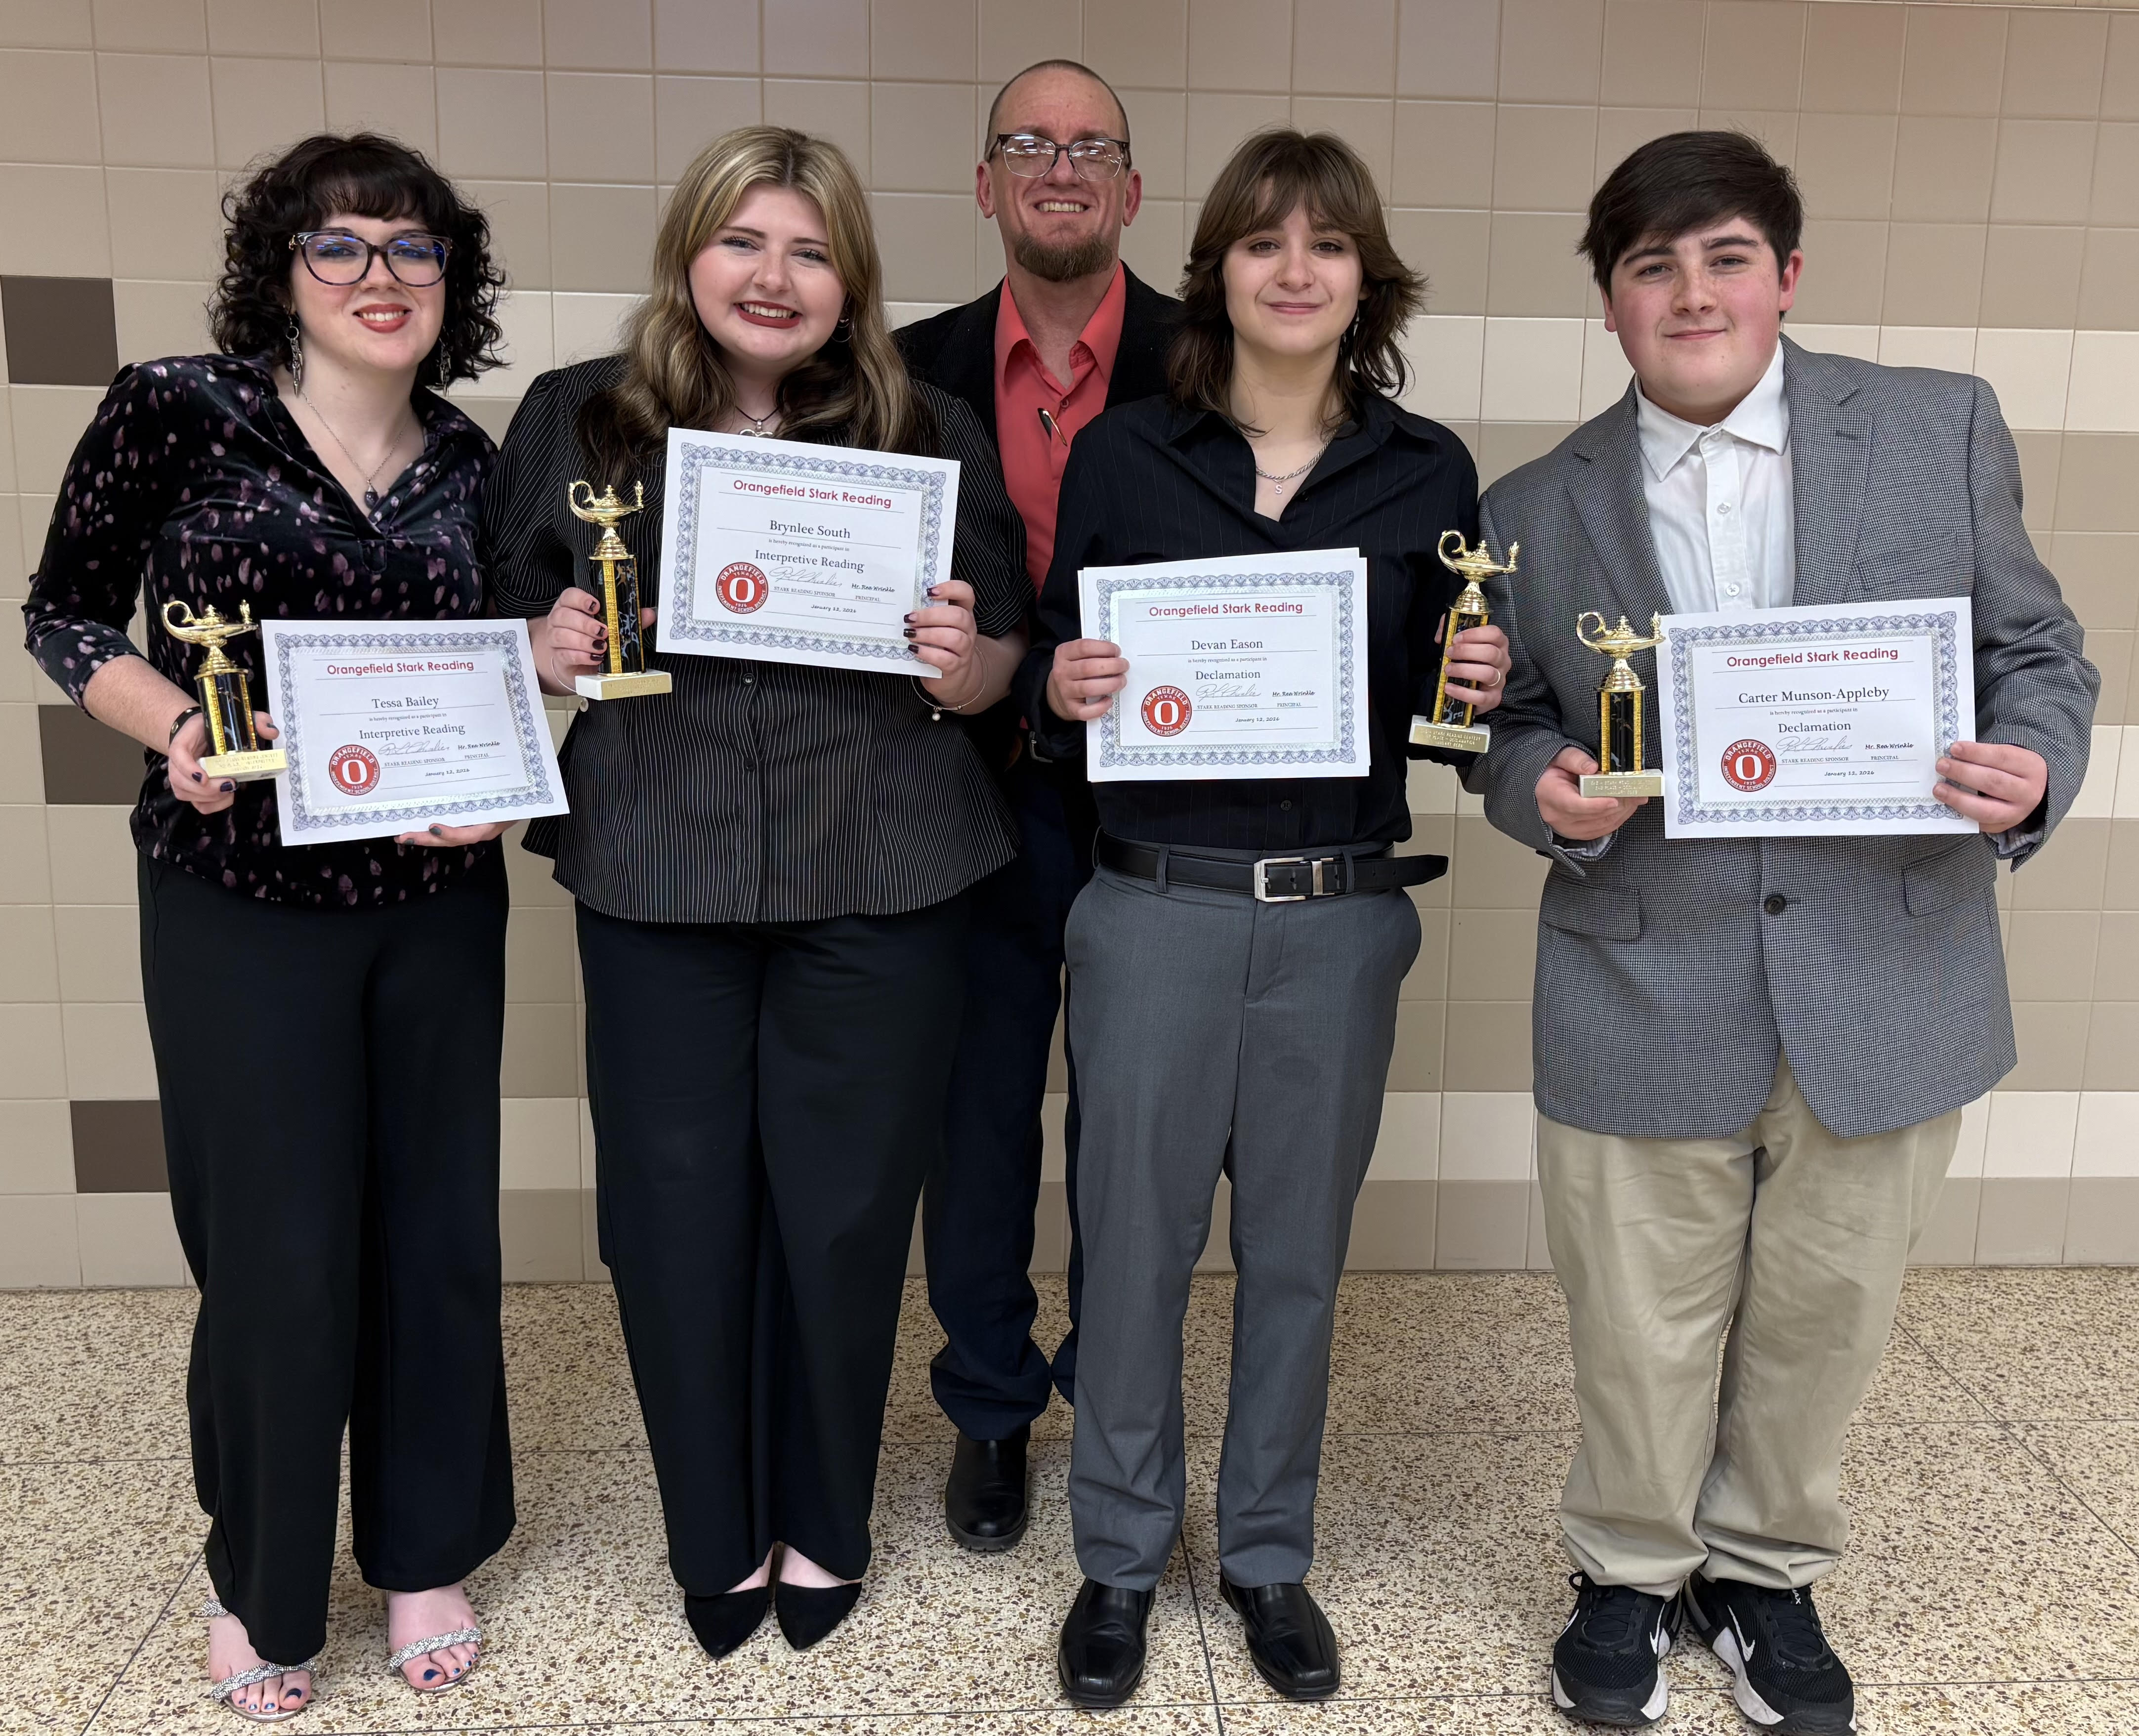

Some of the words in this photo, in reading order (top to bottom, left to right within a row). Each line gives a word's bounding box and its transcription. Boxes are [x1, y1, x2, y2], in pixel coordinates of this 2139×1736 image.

[734, 480, 805, 497] Orangefield
[809, 488, 838, 501] Stark
[842, 492, 891, 508] Reading
[770, 520, 814, 535] Brynlee
[817, 525, 850, 539] South
[755, 550, 817, 565] Interpretive
[821, 557, 865, 574] Reading
[721, 564, 765, 584] ORANGEFIELD
[729, 577, 755, 603] O
[1149, 604, 1218, 617] Orangefield
[1222, 603, 1251, 614] Stark
[1255, 602, 1302, 614] Reading
[1191, 640, 1226, 650] Devan
[1231, 639, 1263, 649] Eason
[1726, 652, 1803, 667] Orangefield
[1807, 651, 1839, 662] Stark
[1844, 648, 1898, 660] Reading
[327, 663, 393, 676] Orangefield
[397, 662, 424, 673] Stark
[427, 661, 474, 671] Reading
[1195, 670, 1260, 680] Declamation
[372, 698, 403, 708] Tessa
[406, 696, 439, 709] Bailey
[1145, 688, 1187, 706] ORANGEFIELD
[1739, 693, 1778, 703] Carter
[1781, 686, 1889, 703] Munson-Appleby
[1154, 700, 1179, 725] O
[359, 727, 419, 740] Interpretive
[422, 724, 465, 735] Reading
[1778, 721, 1851, 733] Declamation
[1725, 742, 1771, 761] ORANGEFIELD
[342, 759, 367, 784] O
[1735, 755, 1762, 780] O
